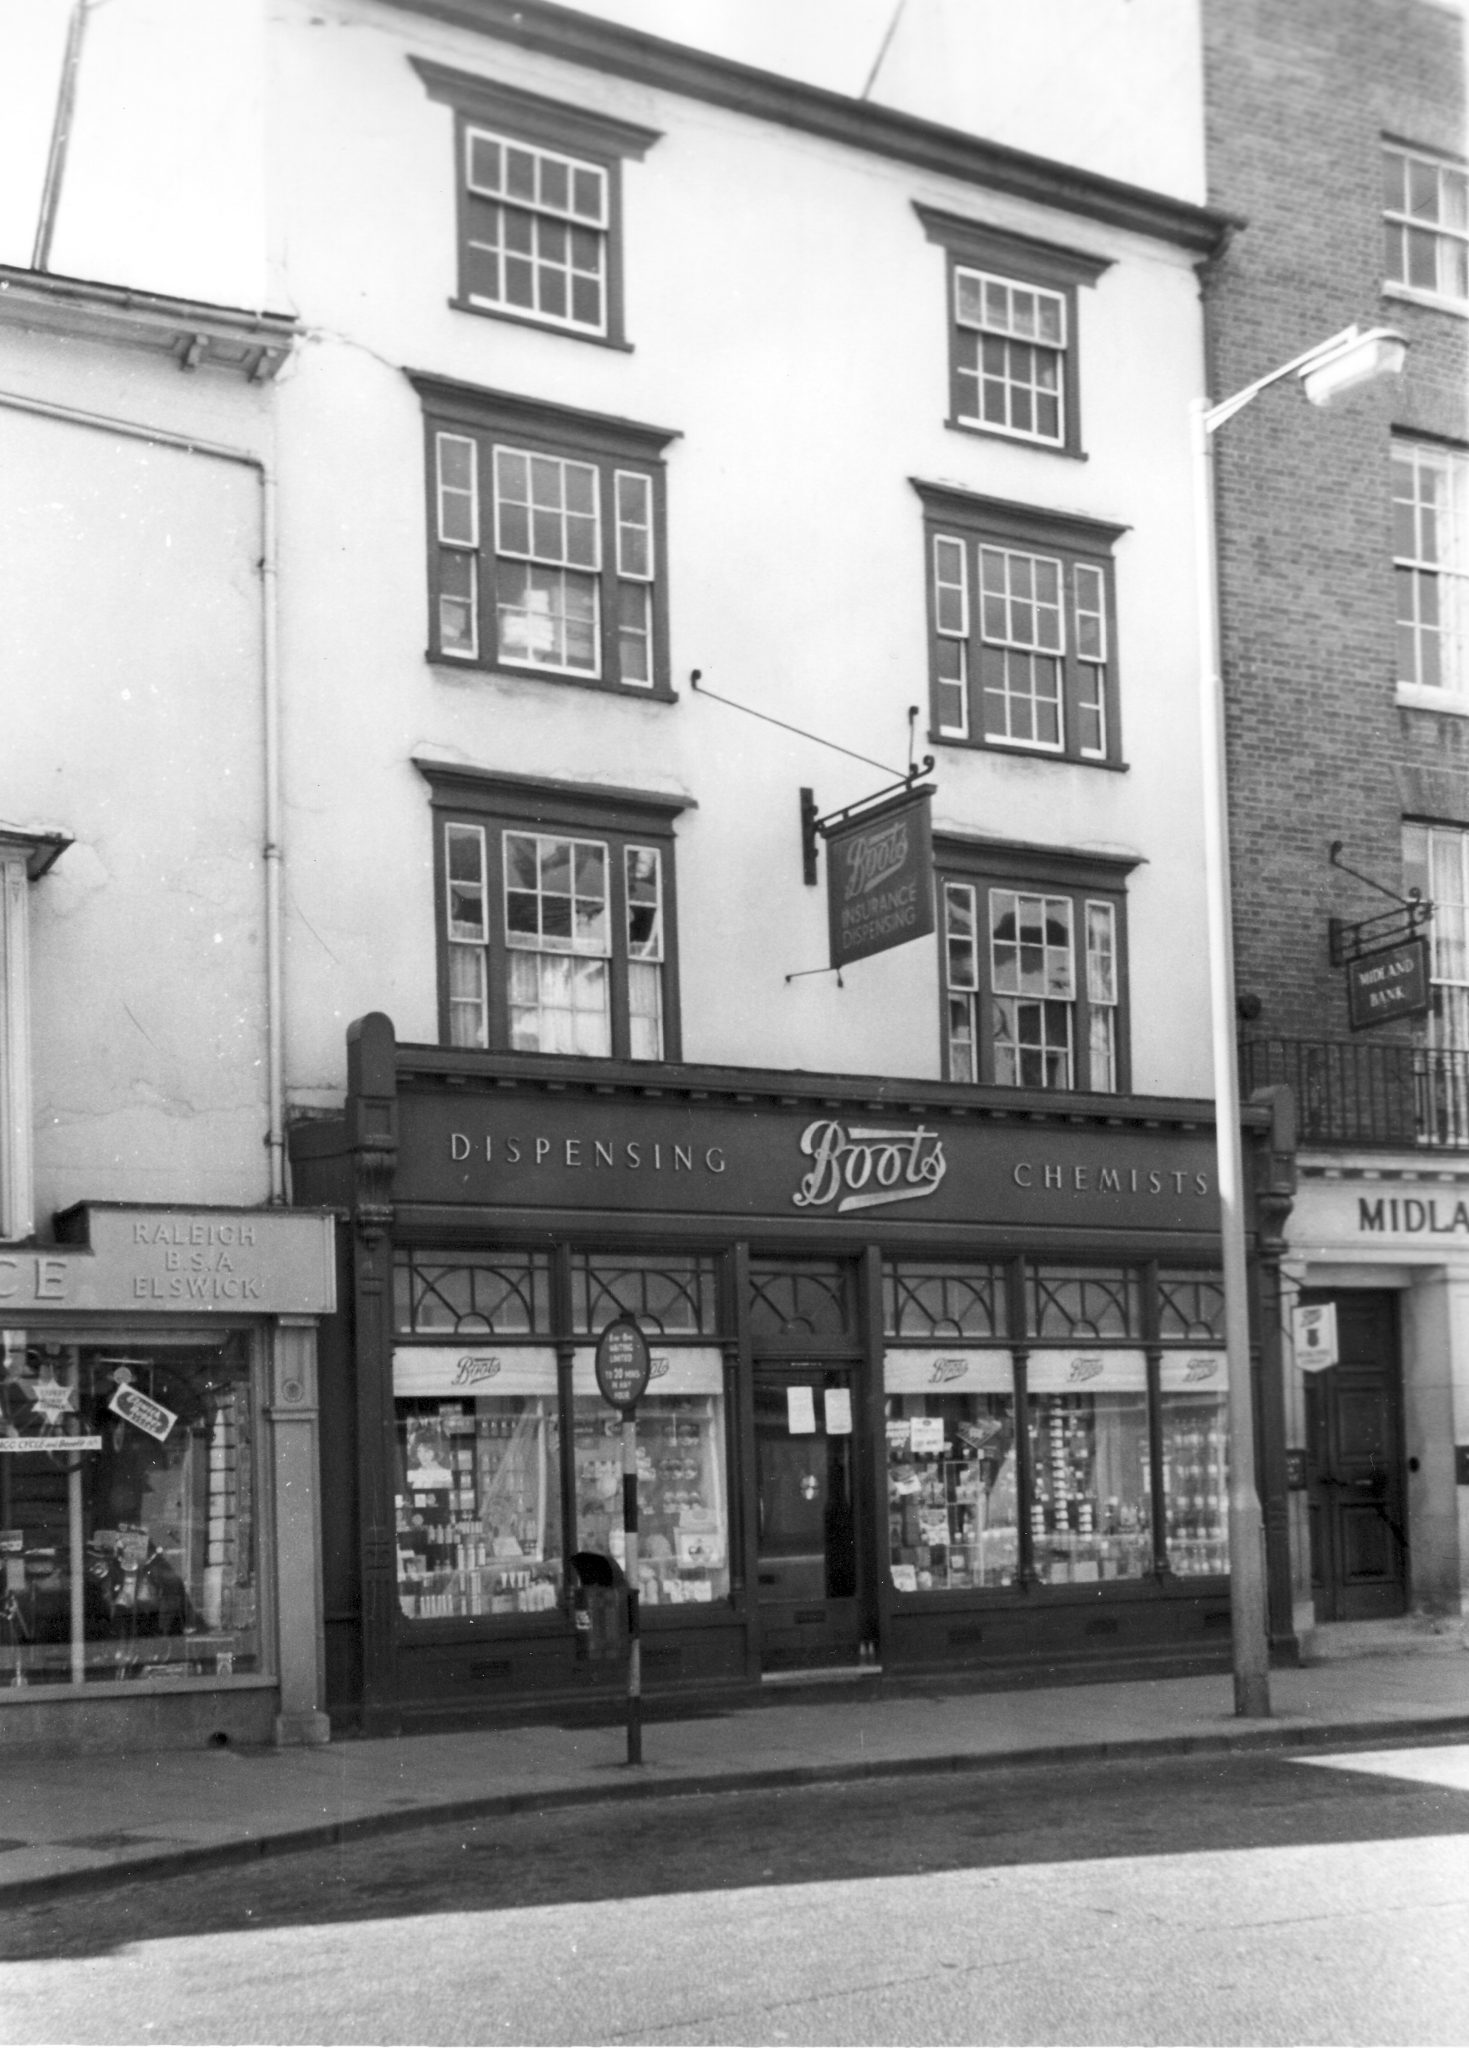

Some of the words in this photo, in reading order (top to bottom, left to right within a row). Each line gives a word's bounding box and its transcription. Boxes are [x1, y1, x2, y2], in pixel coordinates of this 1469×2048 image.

[844, 821, 908, 900] Boots
[840, 883, 917, 928] INSURANCE
[841, 906, 916, 950] DISPENSING
[1358, 957, 1414, 985] MIDLAND
[1369, 985, 1405, 1008] BANK
[451, 1132, 727, 1173] DISPENSING
[792, 1119, 948, 1213] Boots
[1013, 1162, 1207, 1196] CHEMISTS
[1357, 1197, 1469, 1233] MIDLA
[133, 1223, 256, 1246] RALEIGH
[133, 1276, 260, 1299] ELSWICK
[451, 1355, 501, 1385] Boots
[609, 1353, 633, 1363] LIMITED
